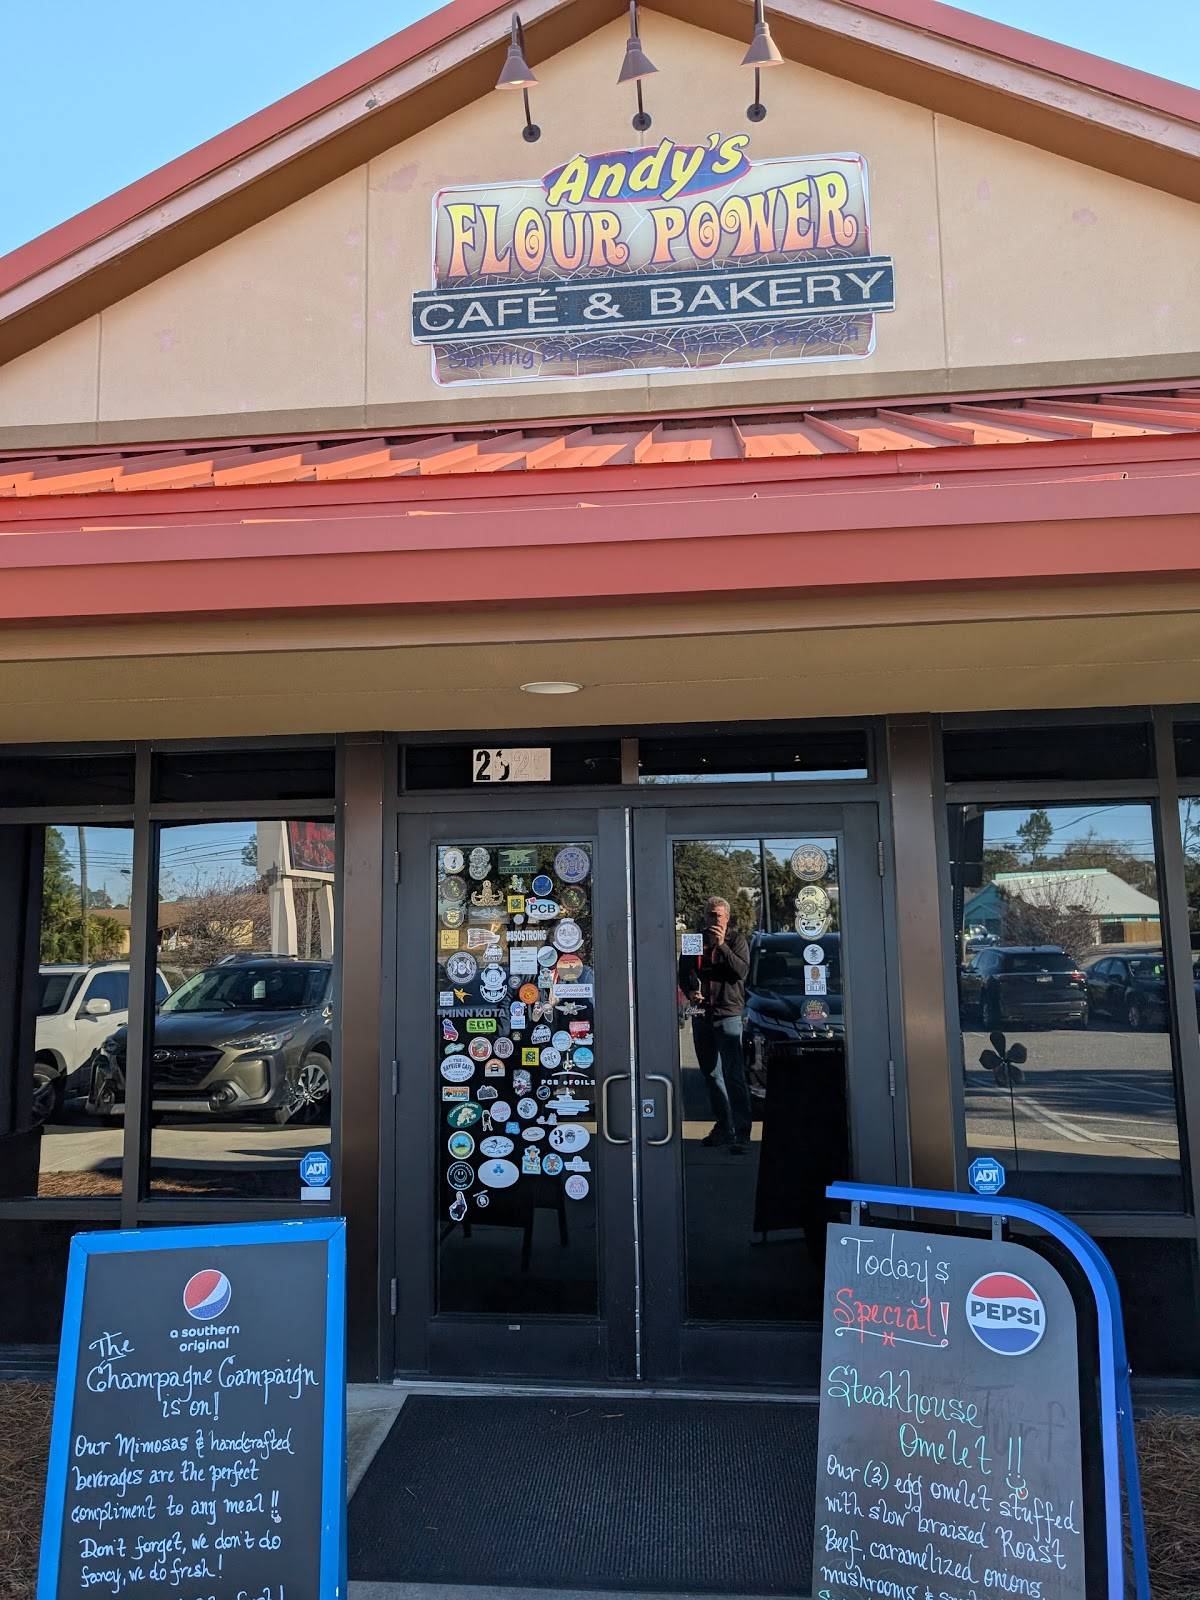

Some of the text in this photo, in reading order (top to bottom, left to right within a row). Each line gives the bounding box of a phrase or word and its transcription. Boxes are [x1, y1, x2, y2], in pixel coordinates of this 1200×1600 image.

[547, 132, 751, 207] Andy's
[444, 171, 857, 278] FLOUR POWER
[420, 269, 886, 332] CAFÉ & BAKERY
[530, 904, 555, 914] PCB
[440, 1009, 506, 1017] MINN KOTA
[305, 1162, 327, 1176] ADT
[975, 1169, 999, 1182] ADT
[840, 1233, 951, 1308] Today's
[970, 1301, 1041, 1326] PEPSI
[89, 1331, 135, 1358] The
[169, 1324, 241, 1339] a southern
[179, 1337, 230, 1354] original
[86, 1355, 320, 1405] Champagne Campaign
[827, 1365, 984, 1428] Steakhouse
[162, 1391, 220, 1421] is on!
[75, 1434, 111, 1457] Our
[115, 1433, 188, 1462] Mimosas
[208, 1428, 295, 1460] handcrafted
[899, 1422, 993, 1475] Omelet
[71, 1458, 260, 1498] beverages are the perfect
[71, 1494, 156, 1530] compliment
[166, 1494, 184, 1516] to
[190, 1503, 217, 1526] any
[223, 1493, 265, 1514] meal
[827, 1454, 1080, 1543] Our (3) egg omelet stuffed
[79, 1529, 281, 1564] Don't forget, we don't do
[825, 1490, 1067, 1570] with slow braised Roast
[80, 1565, 126, 1594] fancy,
[129, 1566, 146, 1581] we
[149, 1561, 167, 1582] do
[869, 1542, 979, 1584] caramelized
[819, 1565, 919, 1600] mushrooms
